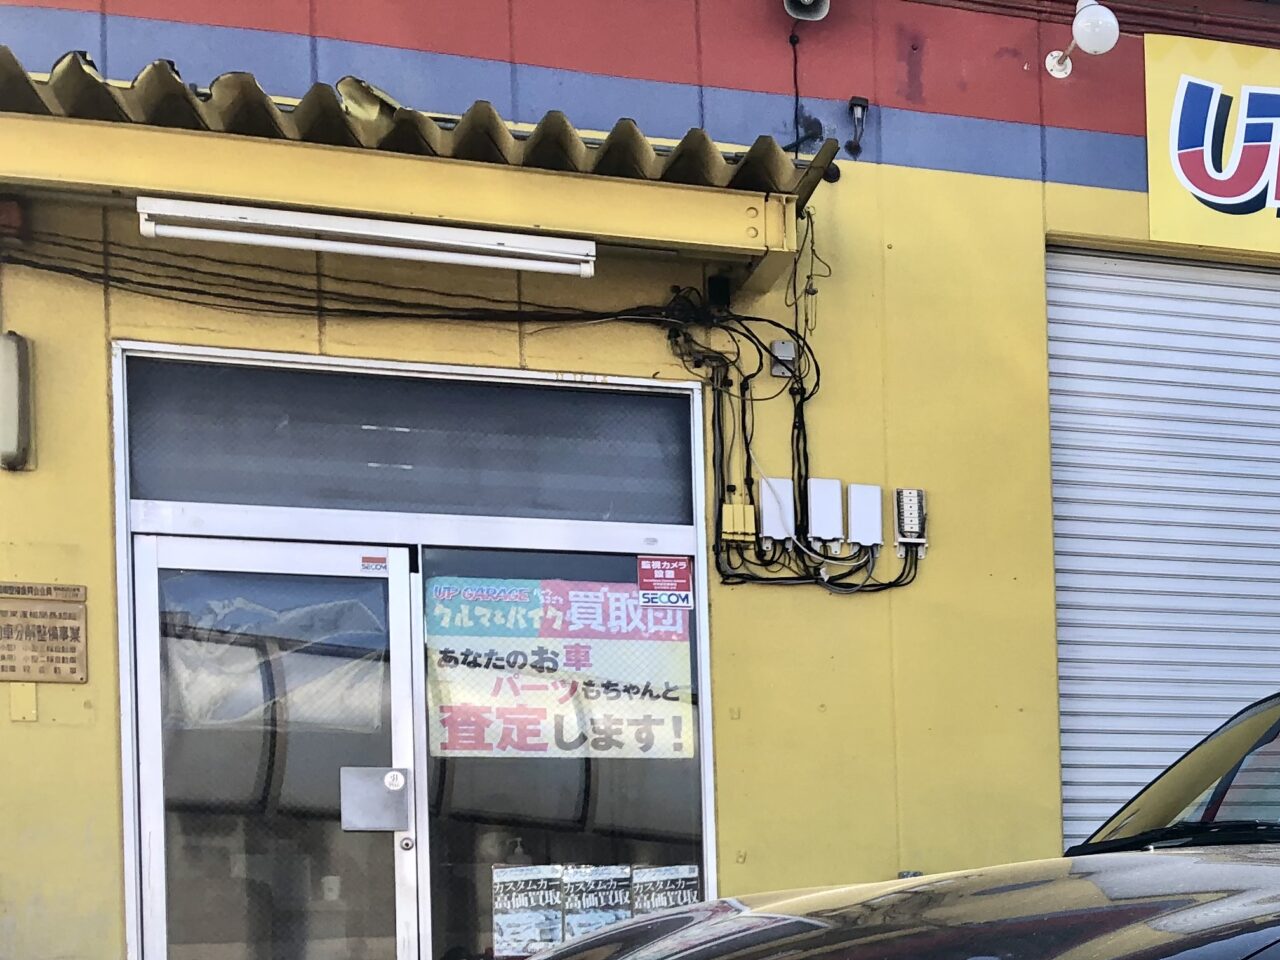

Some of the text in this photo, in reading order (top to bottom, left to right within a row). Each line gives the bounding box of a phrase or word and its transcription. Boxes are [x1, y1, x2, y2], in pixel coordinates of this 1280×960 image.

[433, 585, 459, 601] UP
[461, 586, 530, 603] GARAGE
[642, 593, 689, 604] SECOM
[437, 643, 593, 674] あなたのお車
[490, 673, 681, 705] パーツもちゃんと
[494, 879, 560, 893] カスタムカー
[564, 879, 629, 893] カスタムカー
[633, 879, 698, 893] カスタムカー
